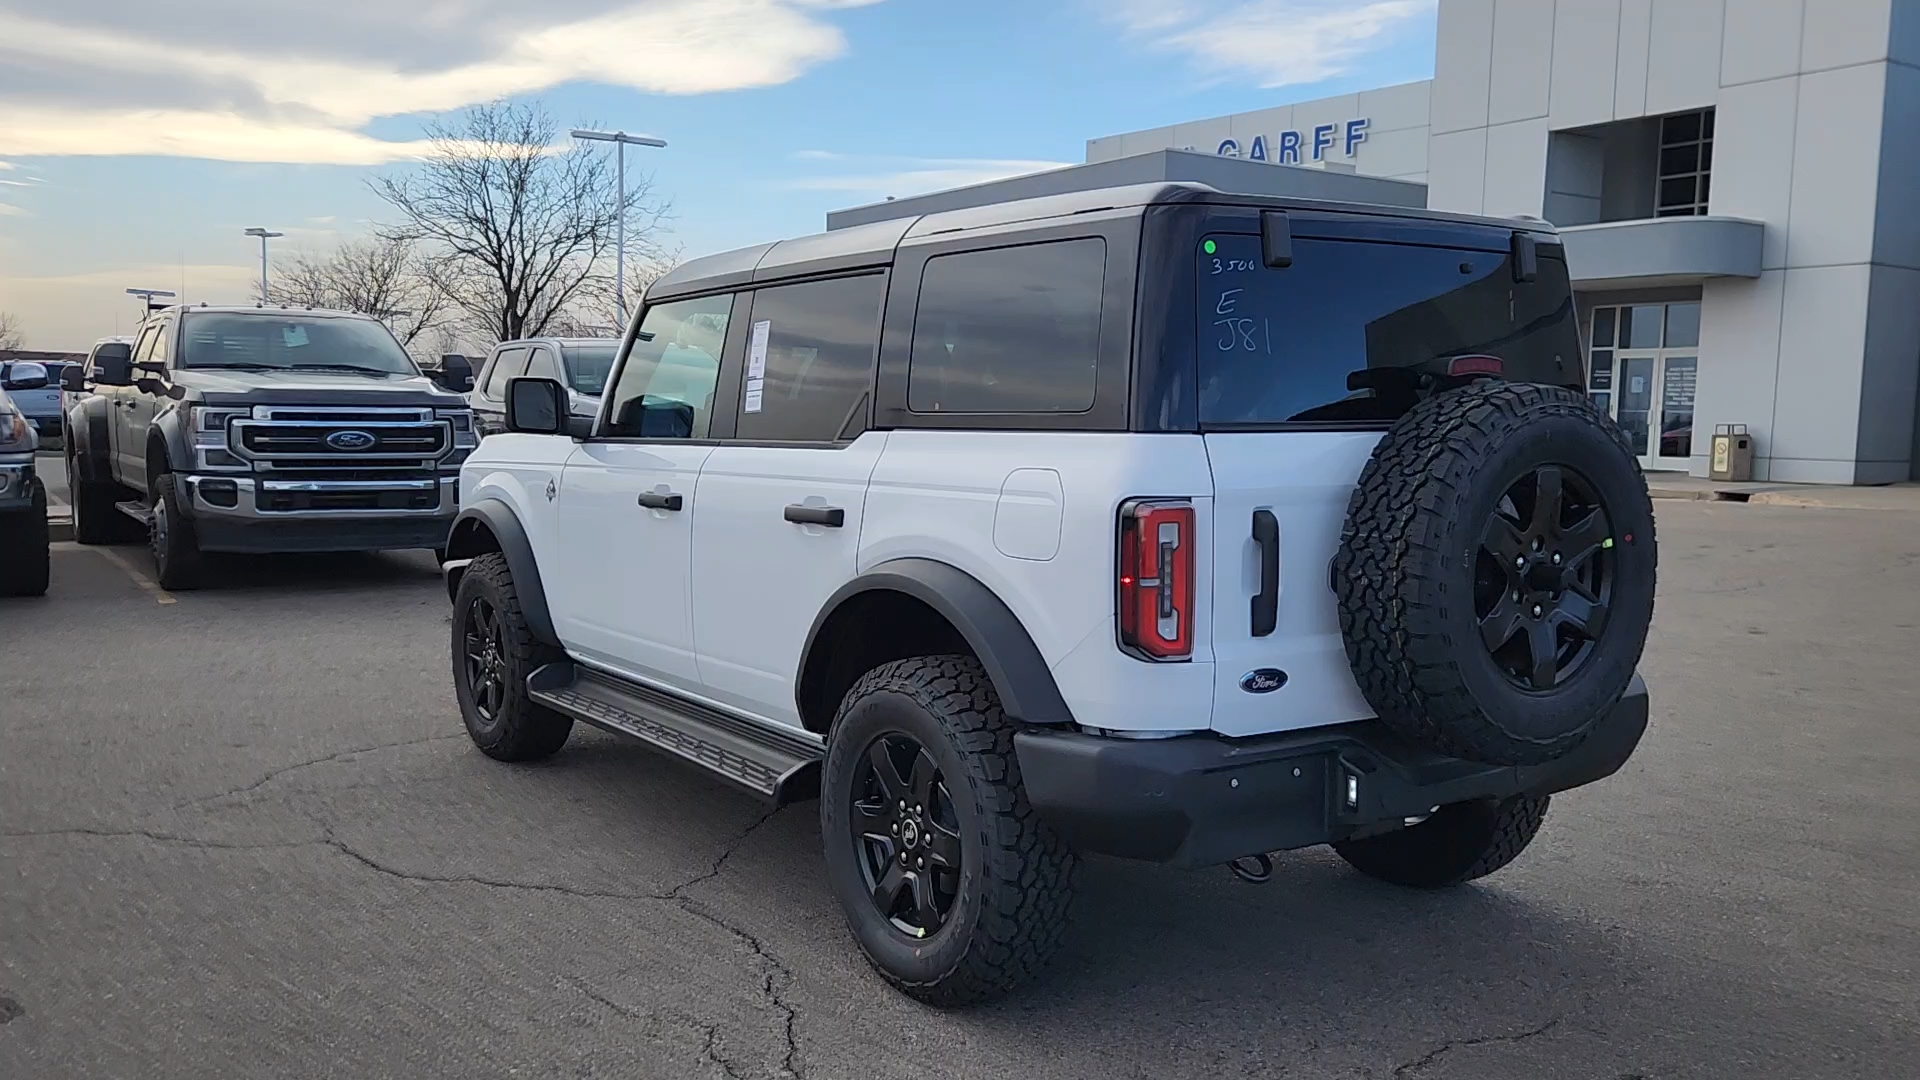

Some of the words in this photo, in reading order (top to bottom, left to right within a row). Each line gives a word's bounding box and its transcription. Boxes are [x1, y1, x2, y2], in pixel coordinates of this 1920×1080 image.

[1217, 118, 1369, 164] GARFF
[1216, 288, 1244, 314] E
[1252, 675, 1279, 689] Ford
